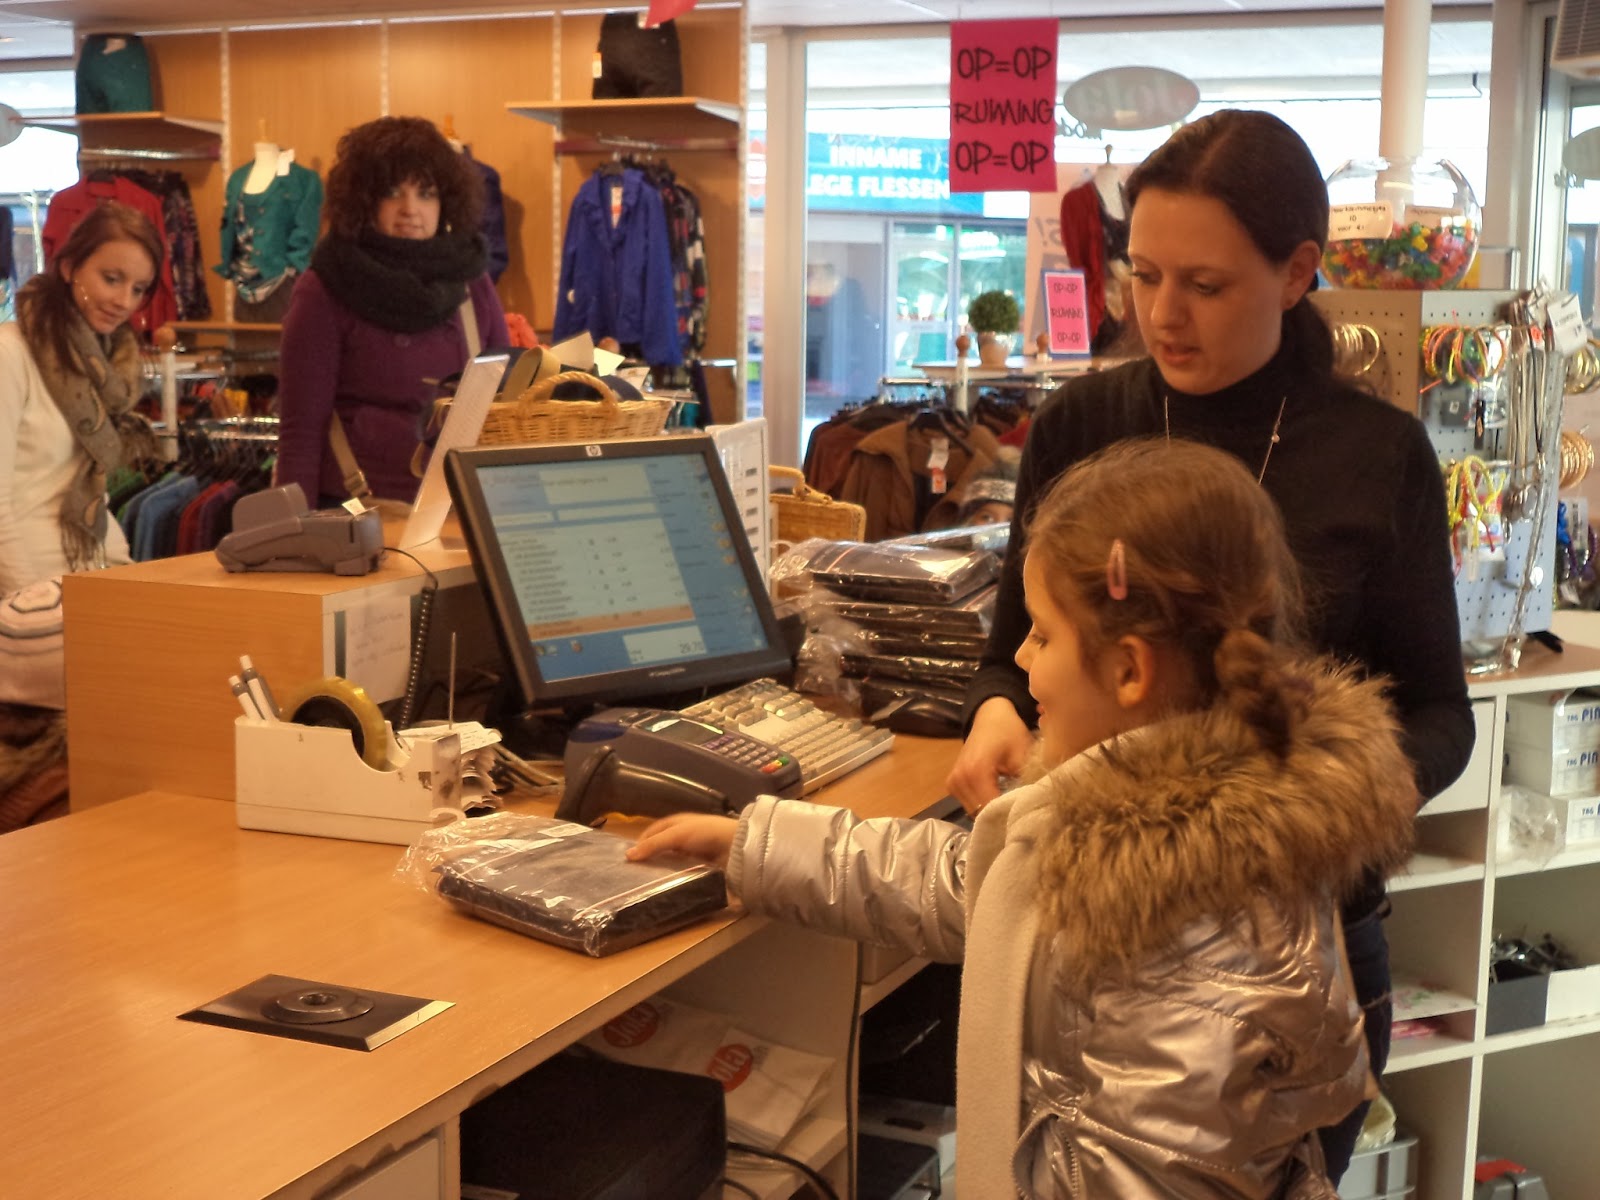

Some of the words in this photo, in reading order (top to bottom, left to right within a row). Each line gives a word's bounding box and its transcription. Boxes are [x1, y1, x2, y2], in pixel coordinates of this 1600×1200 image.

[957, 45, 1052, 81] OP=OP
[954, 98, 1054, 126] RUIMING
[830, 145, 922, 170] INNAME
[955, 141, 1049, 175] OP=OP
[859, 176, 950, 200] FLESSEN
